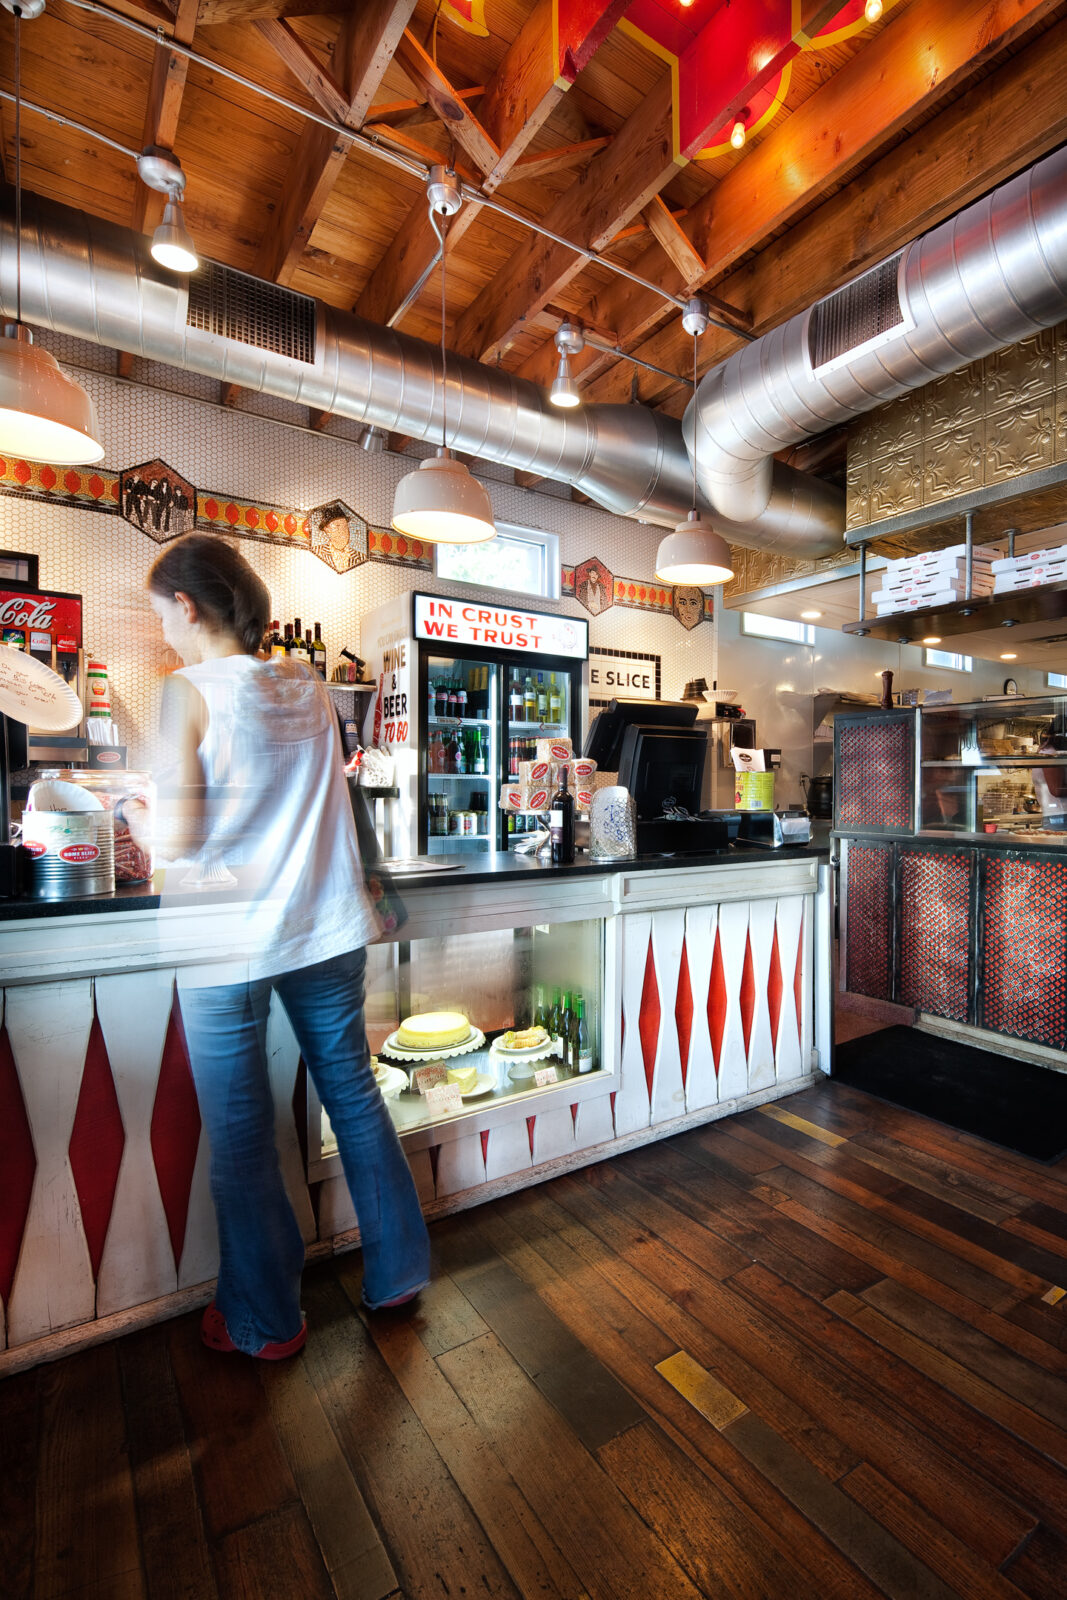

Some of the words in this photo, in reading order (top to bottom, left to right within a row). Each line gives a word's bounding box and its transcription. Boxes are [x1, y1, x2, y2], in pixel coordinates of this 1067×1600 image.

[429, 602, 453, 619] IN
[461, 607, 538, 630] CRUST
[423, 620, 459, 639] WE
[468, 626, 543, 649] TRUST
[383, 644, 406, 674] WINE
[392, 673, 397, 691] &
[606, 671, 651, 689] SLICE
[384, 693, 408, 719] BEER
[384, 721, 396, 743] TO
[396, 720, 409, 742] GO
